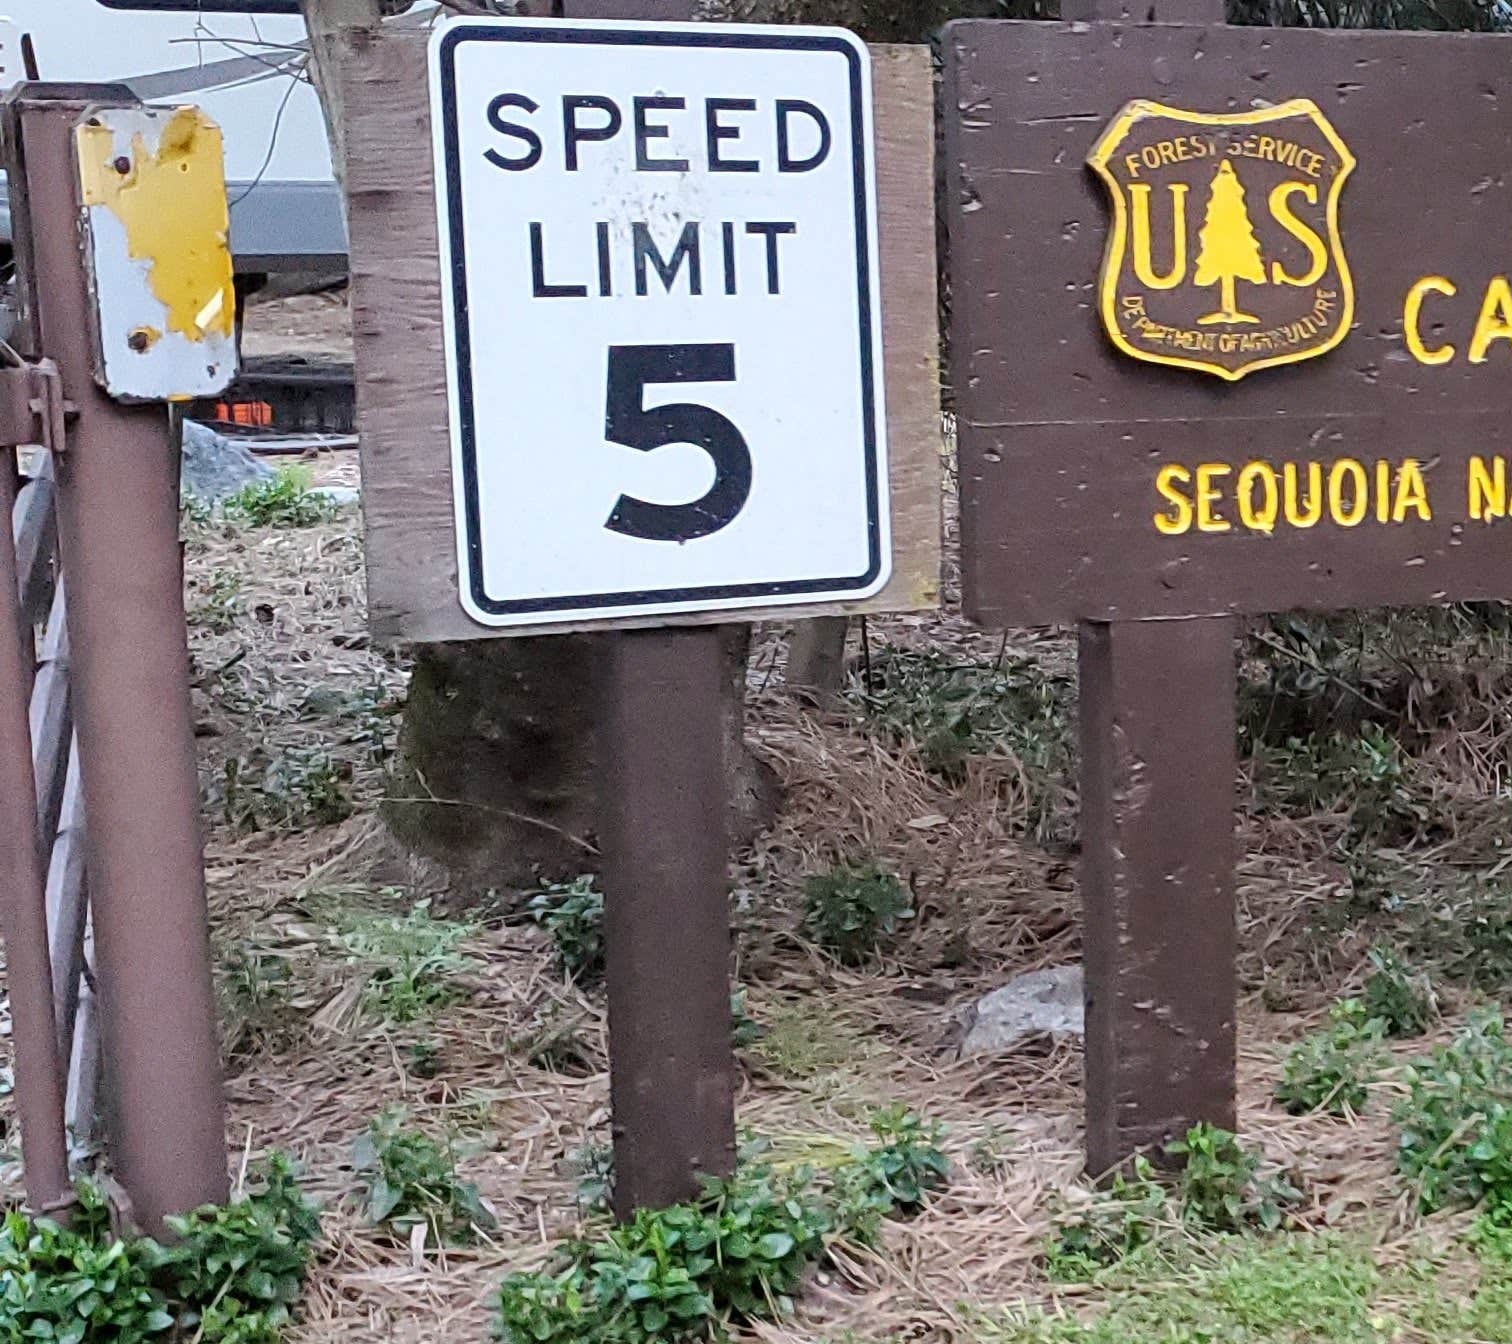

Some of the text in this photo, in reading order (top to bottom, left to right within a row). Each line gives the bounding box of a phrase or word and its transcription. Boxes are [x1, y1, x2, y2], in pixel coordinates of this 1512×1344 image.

[483, 92, 832, 173] SPEED
[1226, 134, 1326, 178] SERVICE
[529, 220, 797, 298] LIMIT
[1122, 295, 1216, 351] DEPTMET
[1240, 288, 1337, 353] AGRULTURE
[603, 342, 753, 544] 5
[1152, 456, 1432, 535] SEQUOIA
